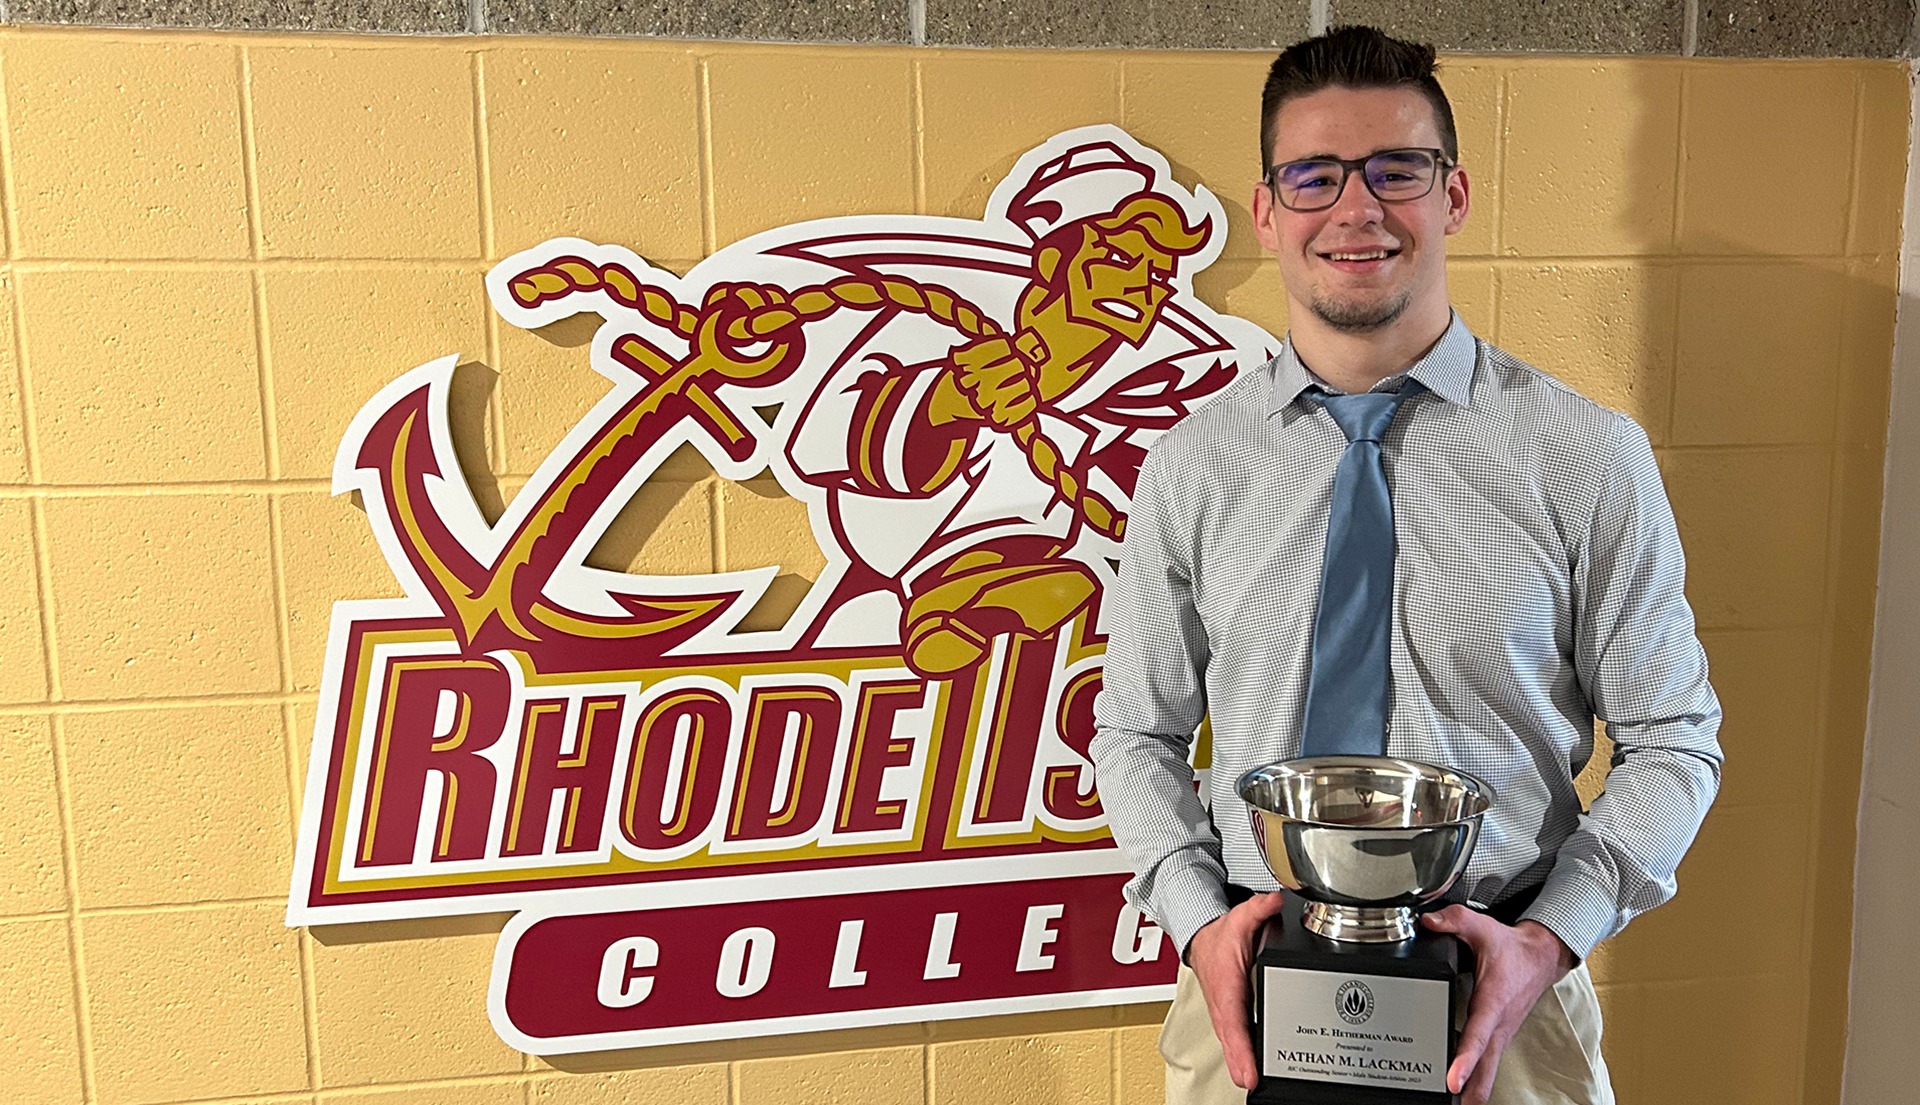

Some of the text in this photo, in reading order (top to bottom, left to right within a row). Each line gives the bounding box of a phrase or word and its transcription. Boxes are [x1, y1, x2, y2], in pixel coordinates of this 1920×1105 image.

[354, 655, 924, 868] RHODE
[597, 902, 1163, 1010] COLLEG
[1320, 1027, 1329, 1036] E.
[1335, 1042, 1366, 1052] Presented
[1277, 1049, 1432, 1074] NATHAN M. LACKMAN
